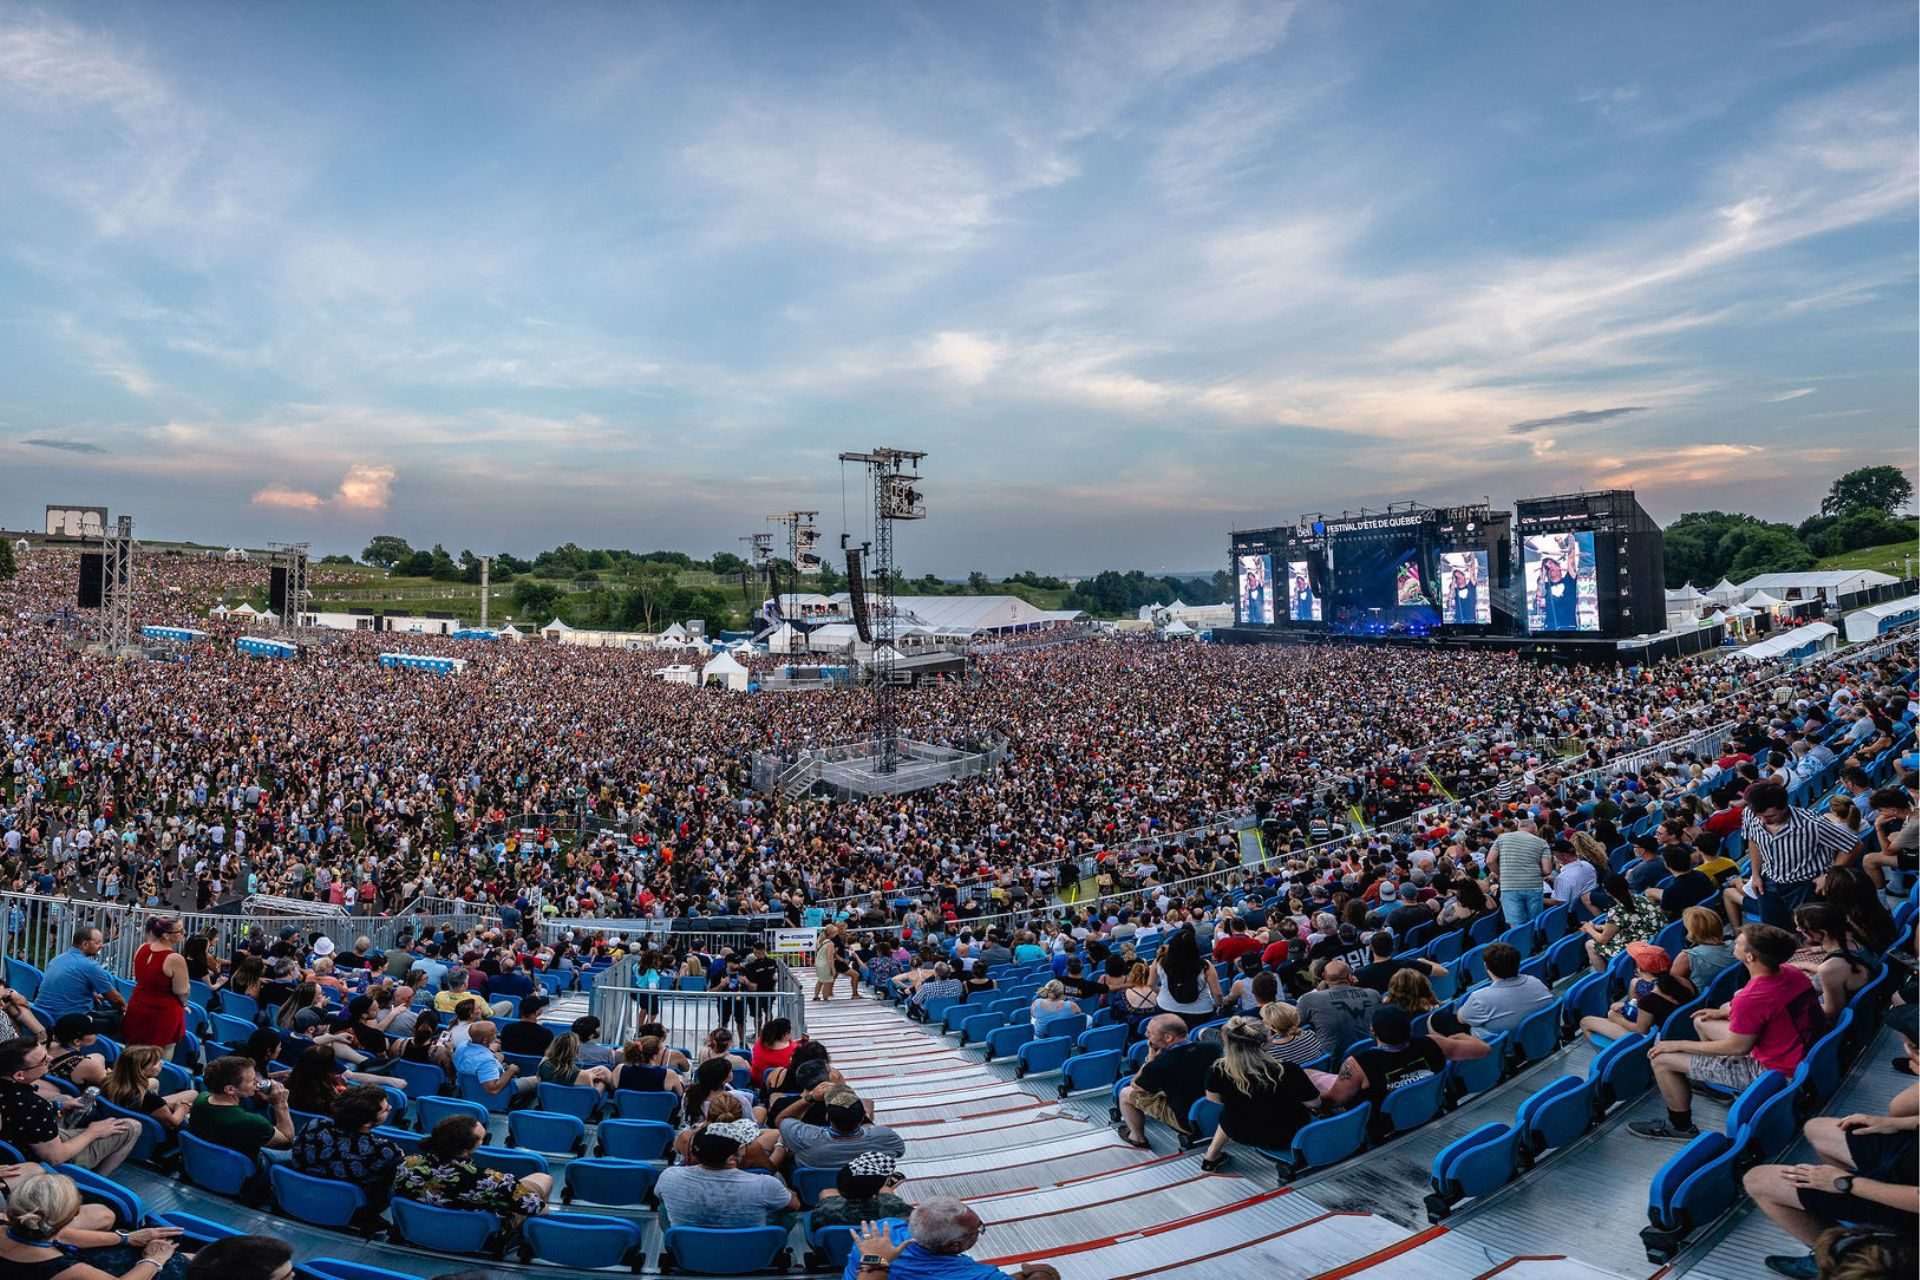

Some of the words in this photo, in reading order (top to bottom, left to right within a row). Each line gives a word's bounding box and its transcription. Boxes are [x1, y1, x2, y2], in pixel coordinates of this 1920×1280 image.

[1326, 523, 1357, 533] FESTIVAL
[1379, 519, 1389, 528] DE
[1389, 516, 1422, 527] QUÉBEC
